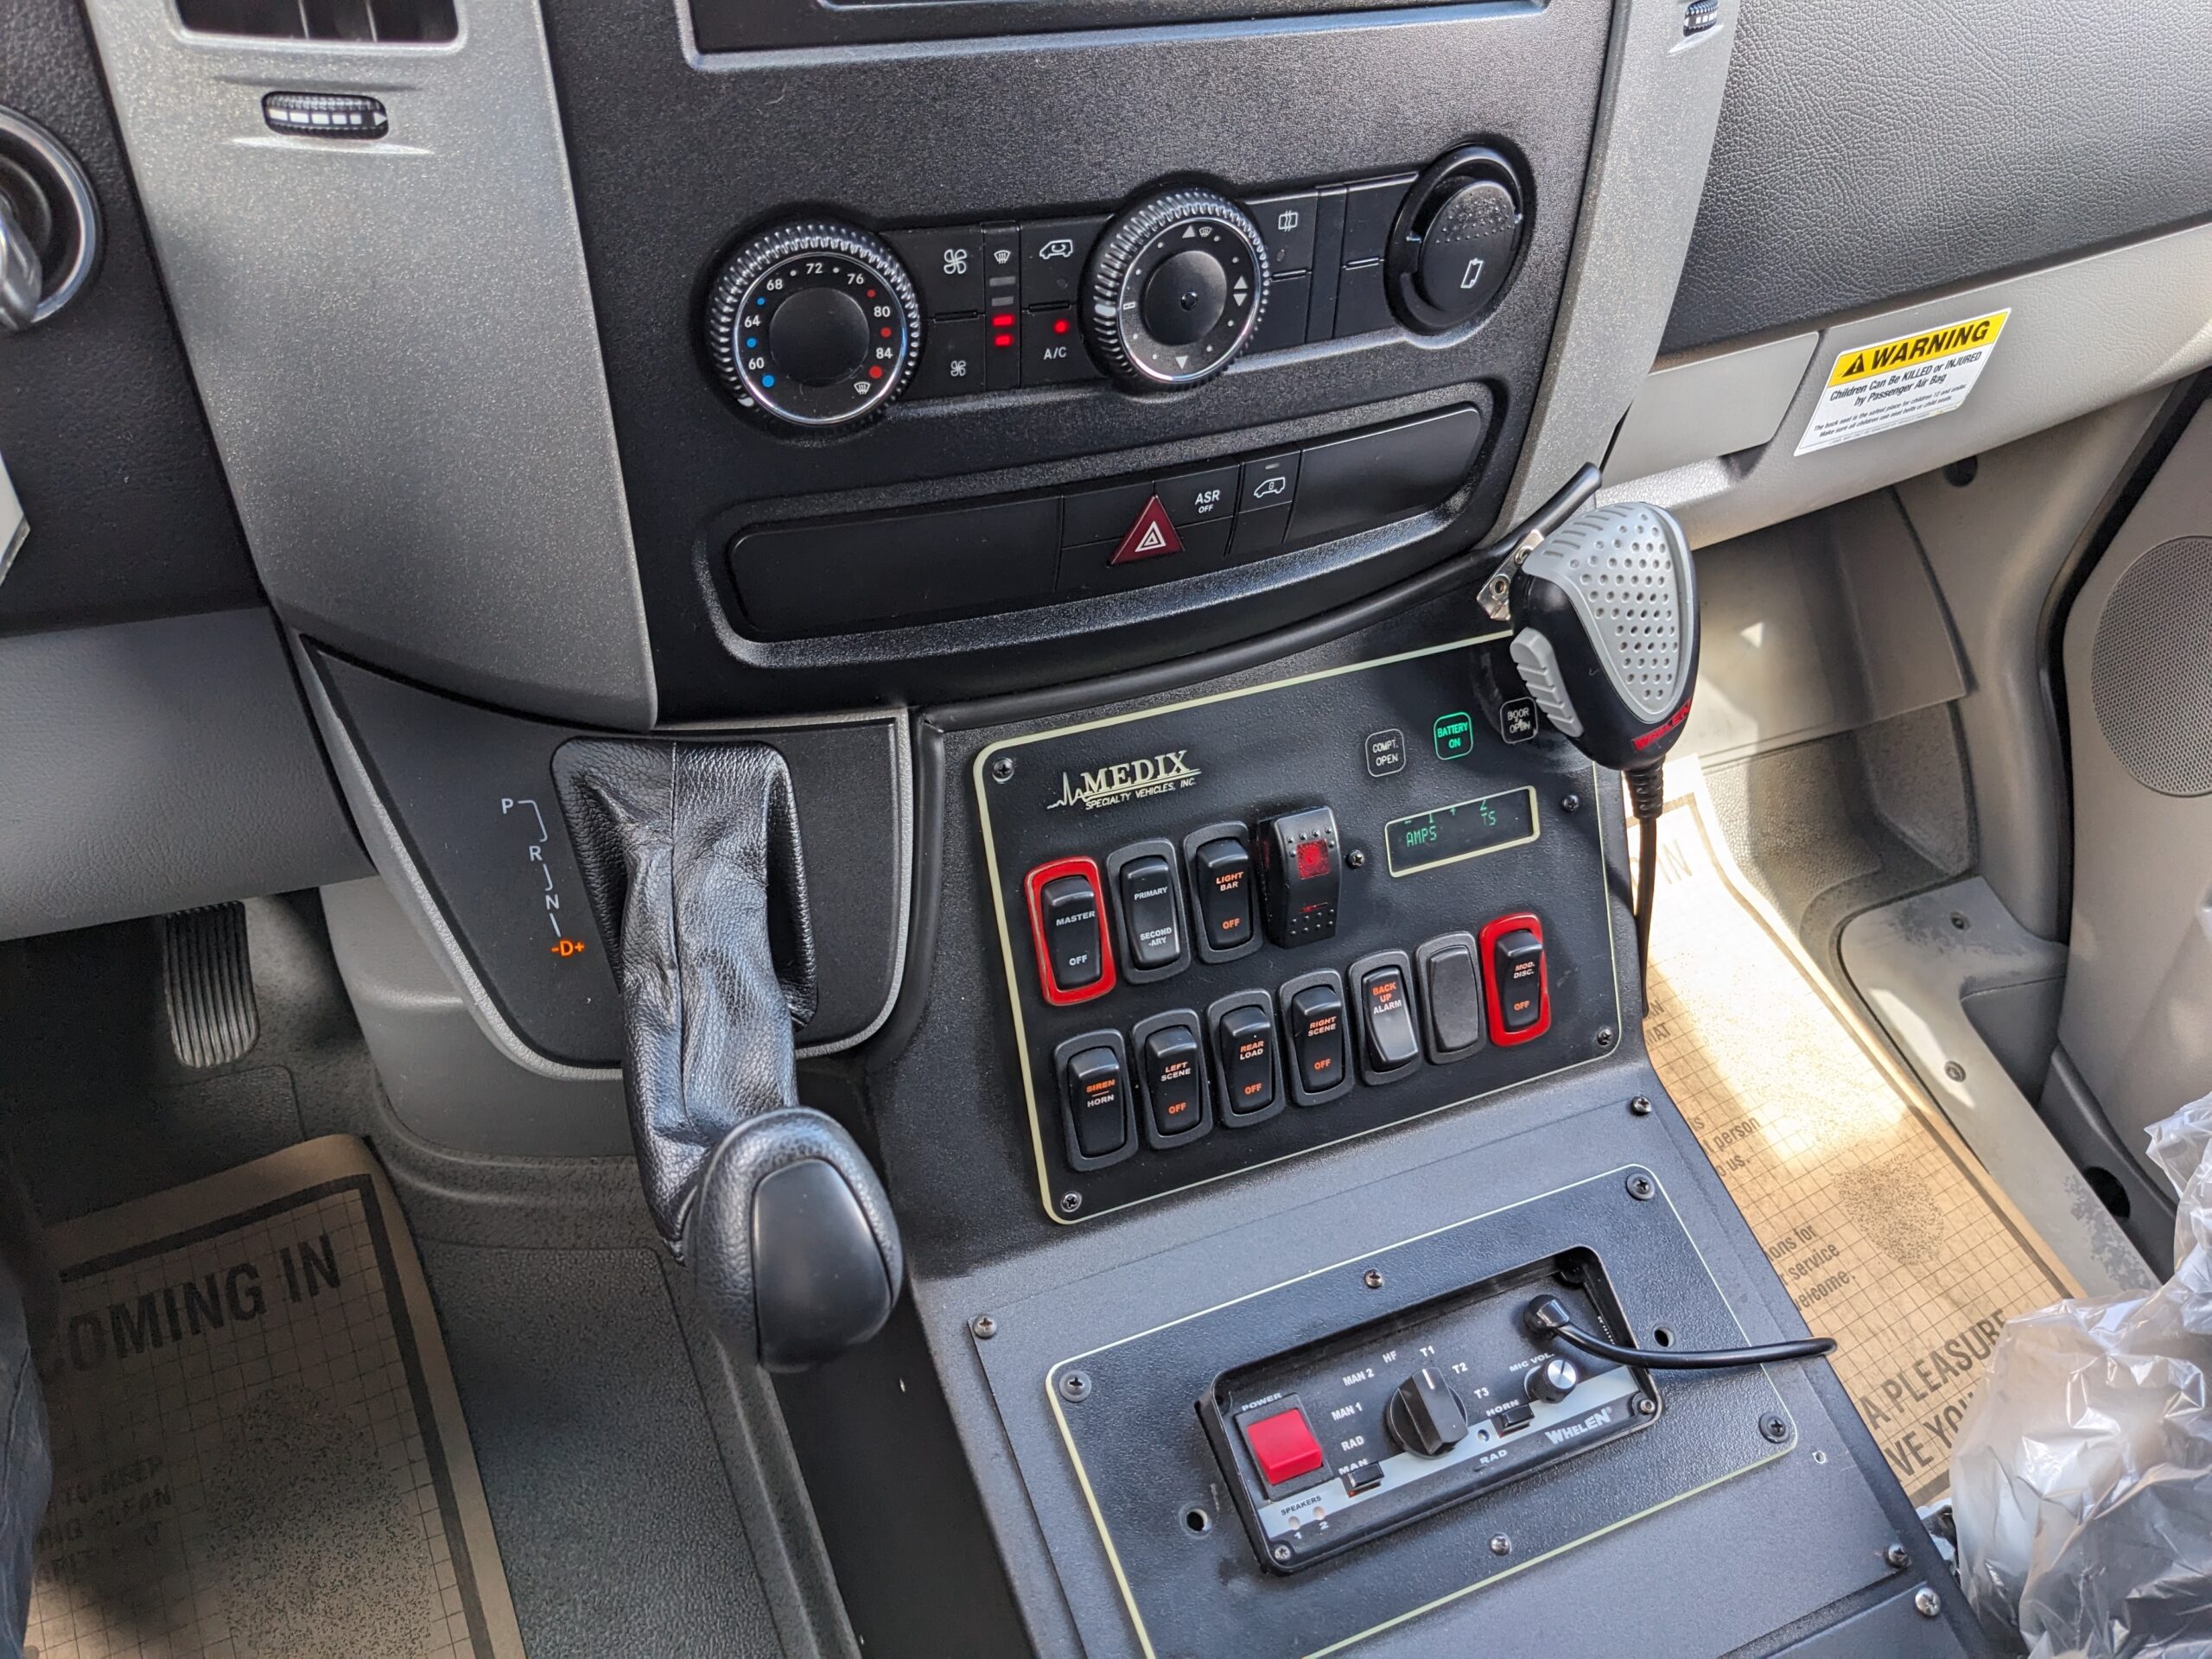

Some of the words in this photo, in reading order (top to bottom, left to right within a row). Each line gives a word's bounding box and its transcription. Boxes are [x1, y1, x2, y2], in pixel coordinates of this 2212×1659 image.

[806, 263, 823, 275] 72
[766, 278, 783, 290] 68
[847, 273, 864, 285] 76
[874, 306, 891, 317] 80
[744, 315, 760, 327] 64
[1871, 320, 1990, 370] WARNING
[875, 347, 893, 359] 84
[1043, 346, 1067, 360] A/C
[748, 358, 765, 370] 60
[1829, 385, 1868, 401] Children
[1869, 379, 1887, 391] Can
[1888, 375, 1901, 385] Be
[1902, 365, 1934, 381] KILLED
[1934, 364, 1944, 373] or
[1945, 351, 1982, 370] INJURED
[1854, 397, 1867, 407] by
[1867, 384, 1914, 403] Passenger
[1914, 378, 1929, 390] Air
[1929, 373, 1947, 385] Bag
[1195, 489, 1220, 505] ASR
[1198, 504, 1214, 513] OFF
[1437, 721, 1469, 737] BATTERY
[1372, 739, 1399, 753] COMPT.
[1448, 738, 1461, 748] ON
[1376, 753, 1399, 766] OPEN
[1081, 750, 1191, 795] MEDIX
[1085, 792, 1130, 810] SPECIALTY
[1135, 782, 1176, 798] VEHICLES,
[1179, 778, 1197, 788] INC.
[501, 798, 514, 815] P
[1407, 826, 1436, 848] AMPS
[529, 845, 543, 861] R
[1216, 872, 1244, 885] LIGHT
[1220, 880, 1238, 892] BAR
[1134, 887, 1168, 900] PRIMARY
[545, 893, 560, 910] N
[1056, 910, 1096, 926] MASTER
[1222, 918, 1241, 930] OFF
[1140, 927, 1172, 942] SECOND
[1147, 936, 1167, 948] -ARY
[1069, 955, 1088, 967] OFF
[1515, 962, 1535, 972] MOD.
[1513, 969, 1535, 979] DISC.
[1372, 982, 1397, 996] BACK
[1380, 993, 1392, 1003] UP
[1373, 1000, 1402, 1014] ALARM
[1514, 1000, 1530, 1012] OFF
[1307, 1023, 1337, 1037] SCENE
[1309, 1016, 1337, 1030] RIGHT
[1240, 1040, 1264, 1053] REAR
[1239, 1048, 1264, 1060] LOAD
[1165, 1061, 1189, 1073] LEFT
[1313, 1058, 1331, 1071] OFF
[1160, 1067, 1192, 1082] SCENE
[1086, 1079, 1116, 1093] SIREN
[1244, 1083, 1262, 1095] OFF
[1087, 1094, 1115, 1108] HORN
[1168, 1102, 1187, 1115] OFF
[1713, 1116, 1761, 1152] person
[1727, 1154, 1751, 1172] us.
[1794, 1224, 1818, 1243] for
[1788, 1243, 1840, 1281] service
[67, 1262, 267, 1371] OMING
[281, 1233, 341, 1303] IN
[1382, 1351, 1398, 1363] HF
[1420, 1344, 1435, 1357] T1
[1452, 1363, 1468, 1375] T2
[1510, 1360, 1530, 1372] MIC
[1530, 1352, 1554, 1364] VOL.
[1343, 1372, 1365, 1386] MAN
[1365, 1369, 1375, 1378] 2
[1474, 1387, 1490, 1400] T3
[1241, 1392, 1282, 1412] POWER
[1486, 1399, 1520, 1416] HORN
[1332, 1405, 1356, 1421] MAN
[1356, 1402, 1363, 1412] 1
[1859, 1395, 1891, 1431] A
[1341, 1435, 1365, 1452] RAD
[1479, 1449, 1508, 1465] RAD
[1338, 1459, 1369, 1475] MAN
[1281, 1495, 1322, 1516] SPEAKERS
[1319, 1521, 1329, 1530] 2
